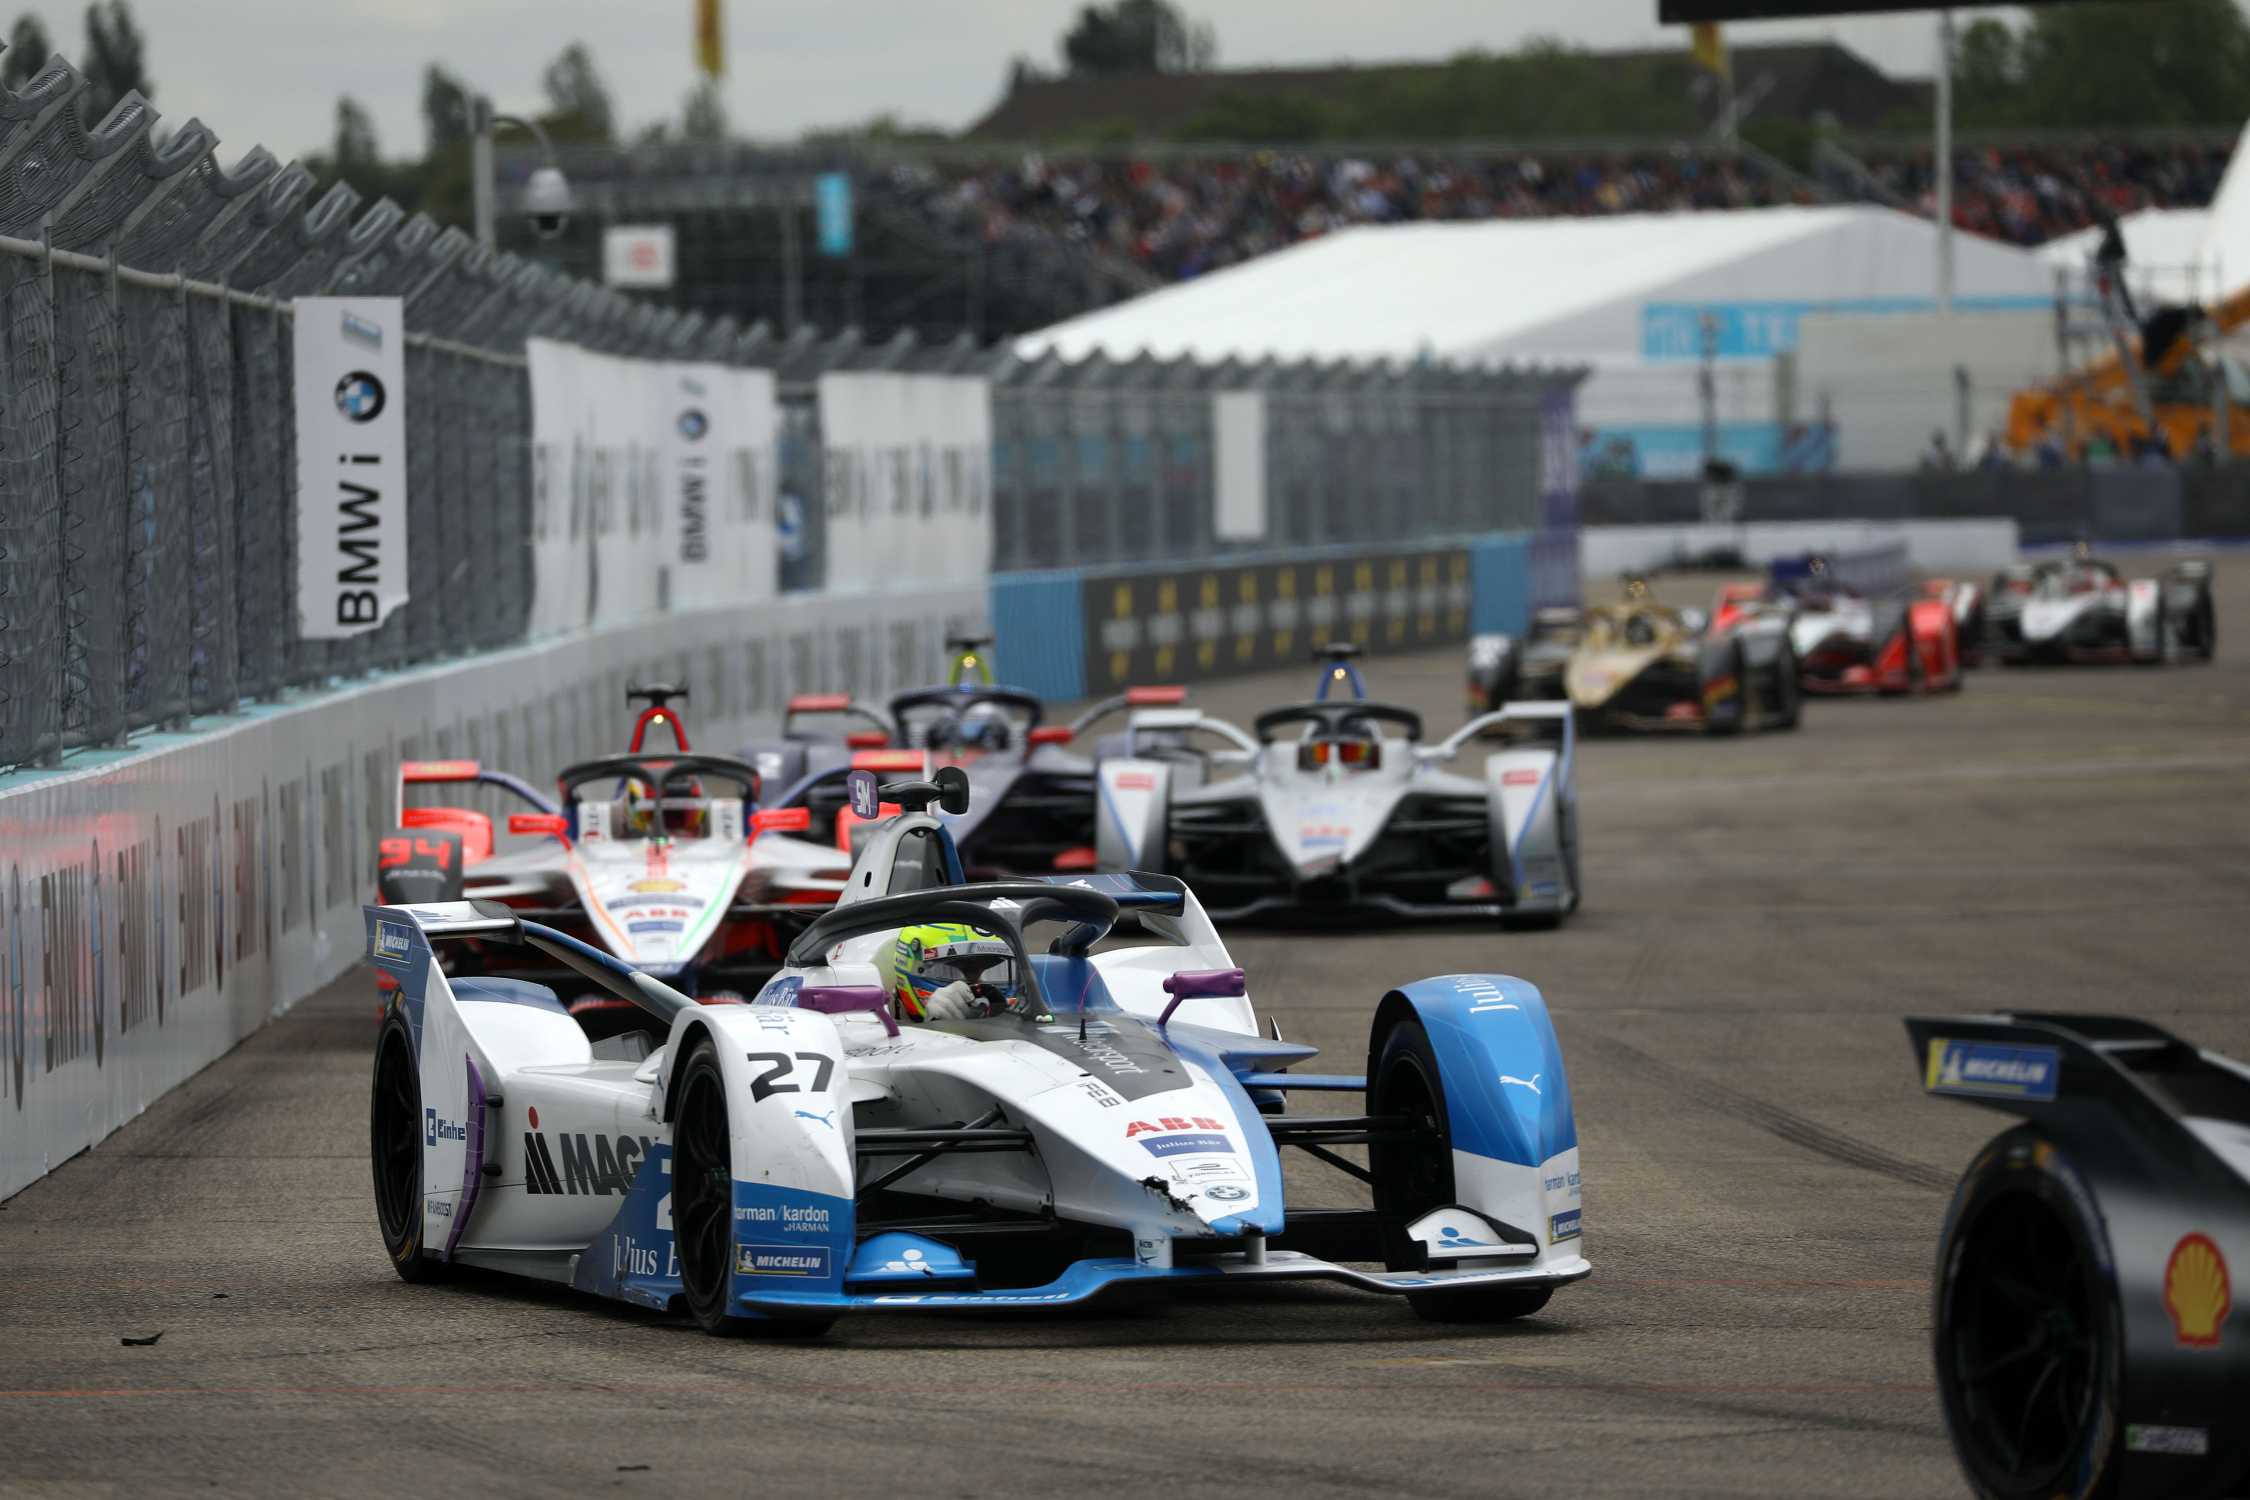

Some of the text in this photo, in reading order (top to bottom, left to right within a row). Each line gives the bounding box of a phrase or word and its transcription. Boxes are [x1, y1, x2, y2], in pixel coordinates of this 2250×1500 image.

[336, 455, 382, 627] BMW i
[378, 838, 451, 871] 94
[746, 1052, 835, 1103] 27
[1965, 1058, 2048, 1084] MICHELIN
[437, 1119, 466, 1141] Einhe
[1126, 1117, 1225, 1138] ABB
[612, 1233, 658, 1279] Julius
[756, 1255, 822, 1269] MICHELIN
